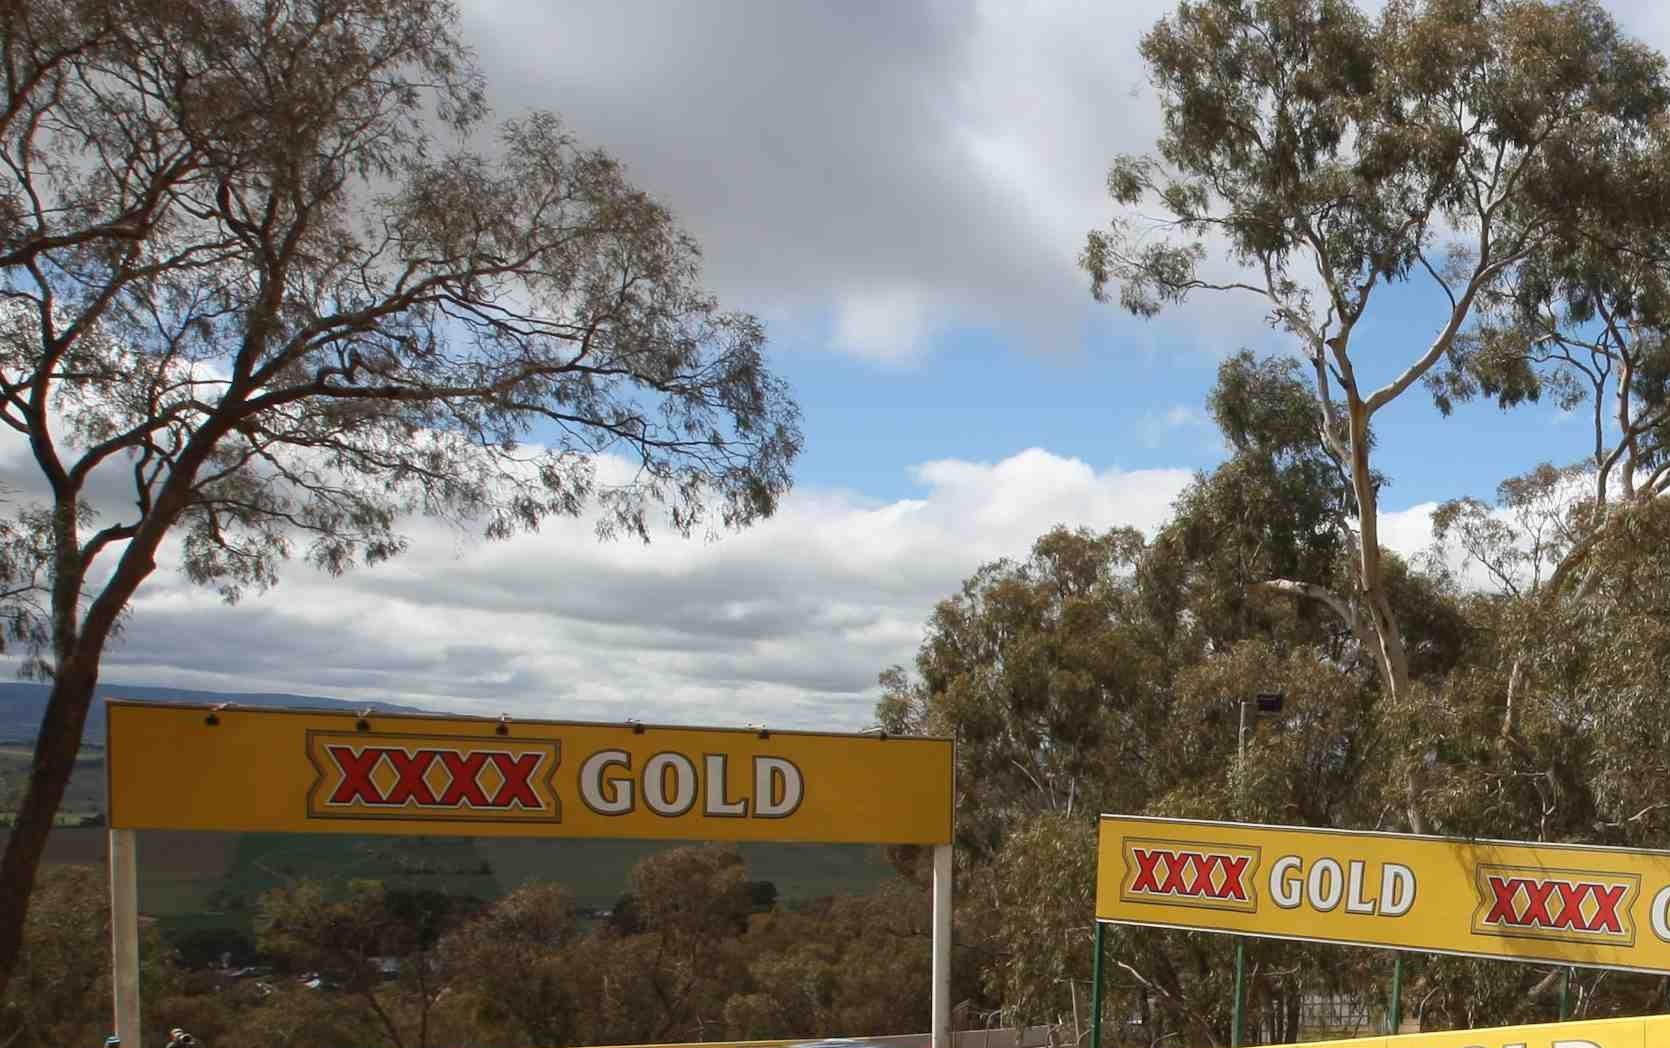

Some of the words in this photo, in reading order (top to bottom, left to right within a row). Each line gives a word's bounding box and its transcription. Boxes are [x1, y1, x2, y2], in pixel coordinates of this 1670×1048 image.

[325, 744, 547, 810] XXXX
[578, 748, 805, 819] GOLD
[1130, 847, 1252, 902] XXXX
[1268, 855, 1417, 918] GOLD
[1483, 876, 1631, 934] XXXX
